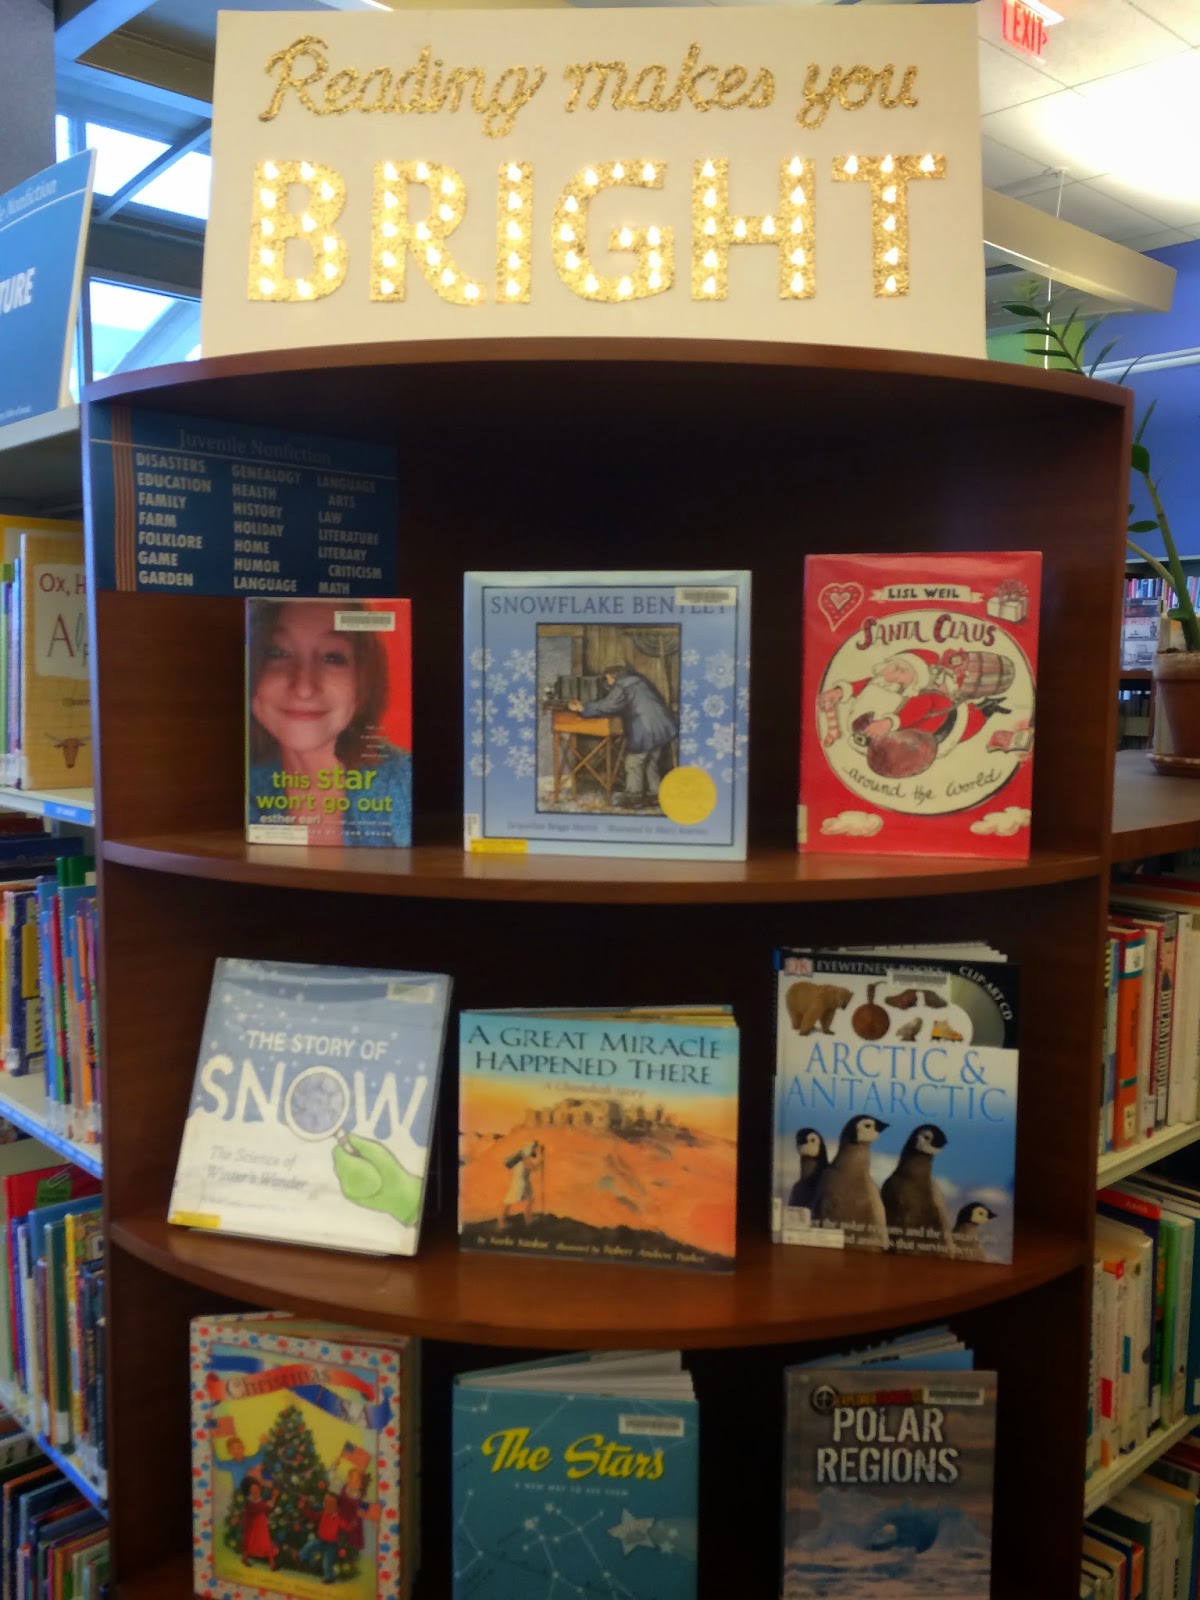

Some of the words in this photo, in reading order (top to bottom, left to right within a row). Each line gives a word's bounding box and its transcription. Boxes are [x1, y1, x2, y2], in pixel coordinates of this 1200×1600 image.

[1012, 0, 1044, 55] EXIT
[259, 35, 548, 139] Reading
[563, 41, 775, 112] makes
[796, 63, 919, 129] you
[247, 154, 947, 304] BRIGHT
[136, 453, 206, 474] DISASTERS
[137, 472, 212, 492] EDUCATION
[231, 464, 301, 484] GENEALOGY
[232, 483, 277, 500] HEALTH
[317, 475, 376, 493] LANGUAGE
[138, 491, 187, 509] FAMILY
[328, 494, 356, 509] ARTS
[138, 511, 177, 528] FARM
[233, 501, 283, 519] HISTORY
[318, 510, 343, 524] LAW
[233, 520, 286, 537] HOLIDAY
[318, 529, 379, 546] LITERATURE
[138, 531, 203, 549] FOLKLORE
[234, 539, 270, 555] HOME
[138, 551, 178, 567] GAME
[318, 546, 367, 561] LITERARY
[234, 558, 280, 573] HUMOR
[328, 564, 382, 580] CRITICISM
[39, 572, 70, 596] Ox,
[138, 570, 194, 587] GARDEN
[233, 576, 298, 592] LANGUAGE
[318, 581, 351, 595] MATH
[888, 588, 918, 599] LISL
[924, 588, 960, 599] WEIL
[491, 595, 624, 615] SNOWFLAKE
[272, 770, 310, 790] this
[317, 764, 377, 790] star
[843, 766, 907, 799] around
[256, 792, 316, 812] won't
[322, 796, 351, 814] go
[357, 795, 392, 812] out
[260, 813, 297, 825] esther
[246, 1030, 287, 1052] THE
[291, 1034, 355, 1057] STORY
[360, 1041, 389, 1061] OF
[468, 1025, 491, 1046] A
[500, 1026, 588, 1050] GREAT
[600, 1032, 721, 1060] MIRACLE
[475, 1051, 617, 1077] HAPPENED
[627, 1058, 713, 1085] THERE
[805, 1041, 947, 1084] ARCTIC
[960, 1050, 989, 1086] &
[200, 1053, 428, 1142] SNOW
[784, 1076, 1007, 1123] ANTARCTIC
[833, 1406, 944, 1443] POLAR
[481, 1427, 552, 1473] The
[564, 1433, 665, 1480] Stars
[816, 1447, 959, 1484] REGIONS
